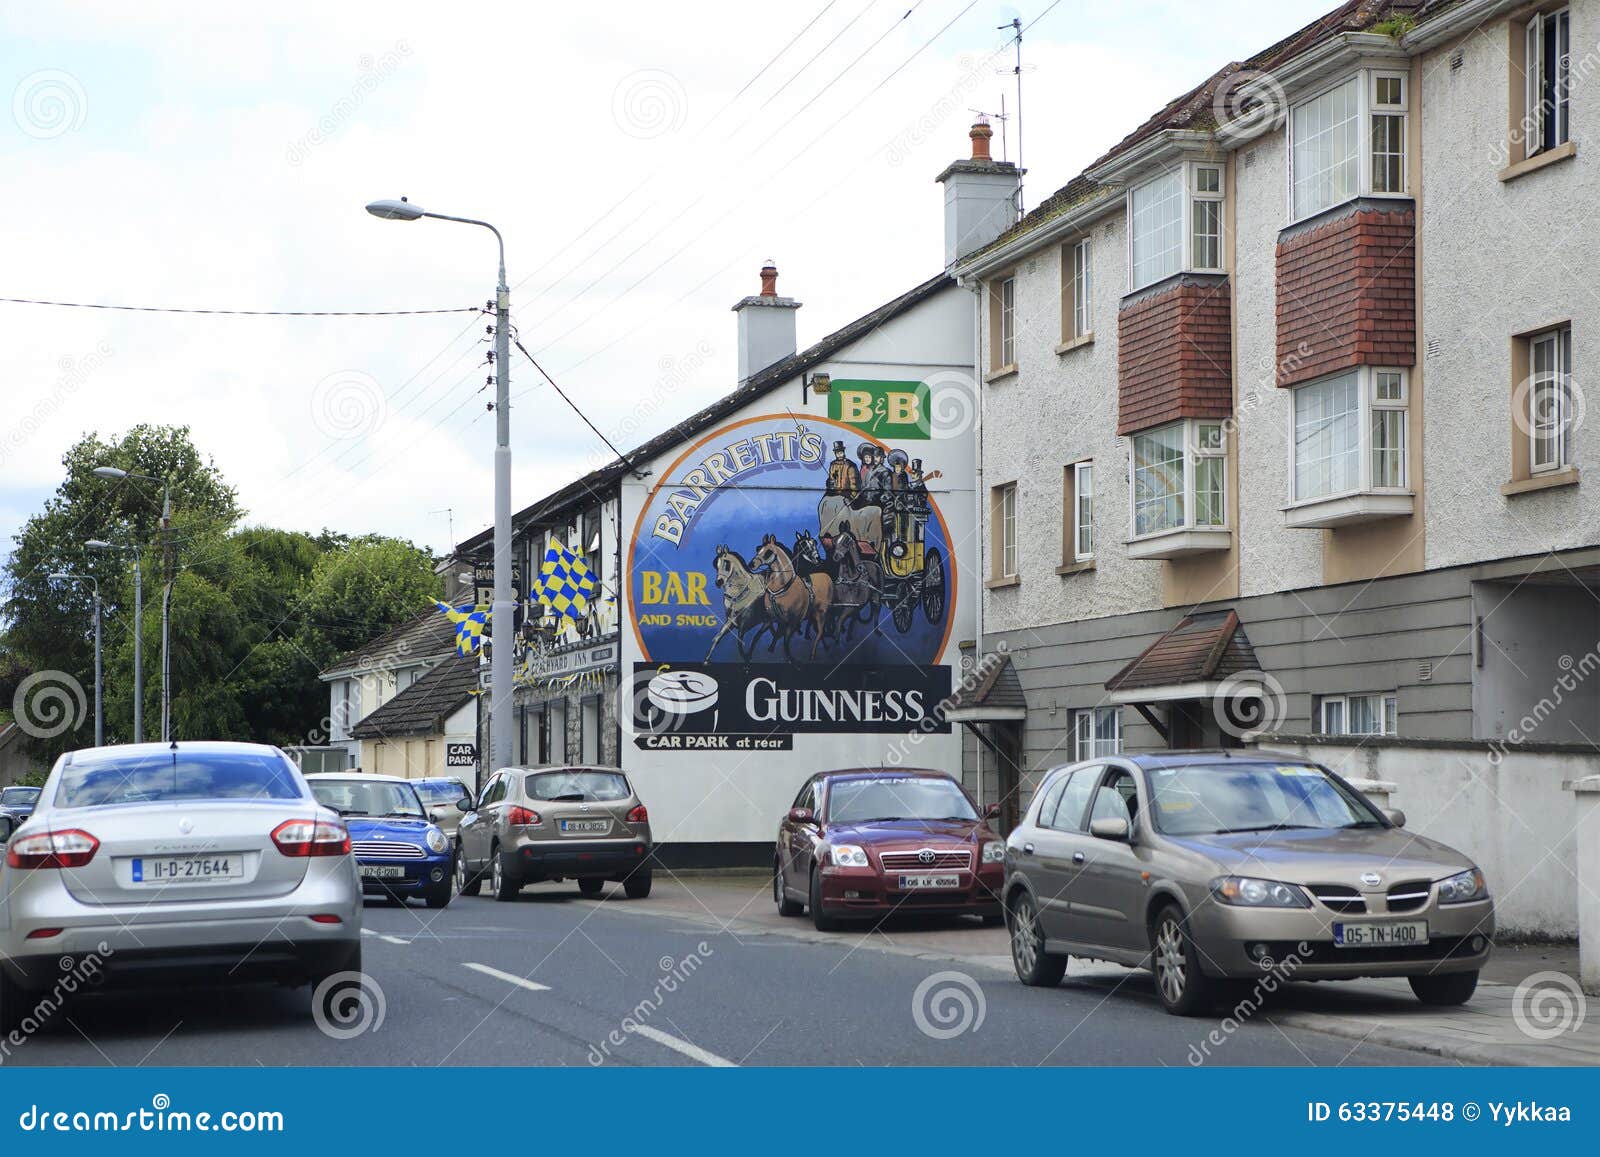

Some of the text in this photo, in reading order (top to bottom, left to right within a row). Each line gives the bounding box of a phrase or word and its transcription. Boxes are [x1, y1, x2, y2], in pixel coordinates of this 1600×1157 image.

[839, 390, 920, 432] B&B
[652, 424, 823, 550] BARRETT'S
[640, 571, 712, 605] BAR
[639, 614, 717, 626] AND SNUG
[745, 677, 925, 722] GUINNESS
[450, 745, 472, 755] CAR
[646, 736, 784, 748] CAR PARK at rear
[448, 755, 474, 765] PARK
[154, 859, 230, 878] 11-D-27644
[1346, 926, 1417, 943] 05-TN-1400
